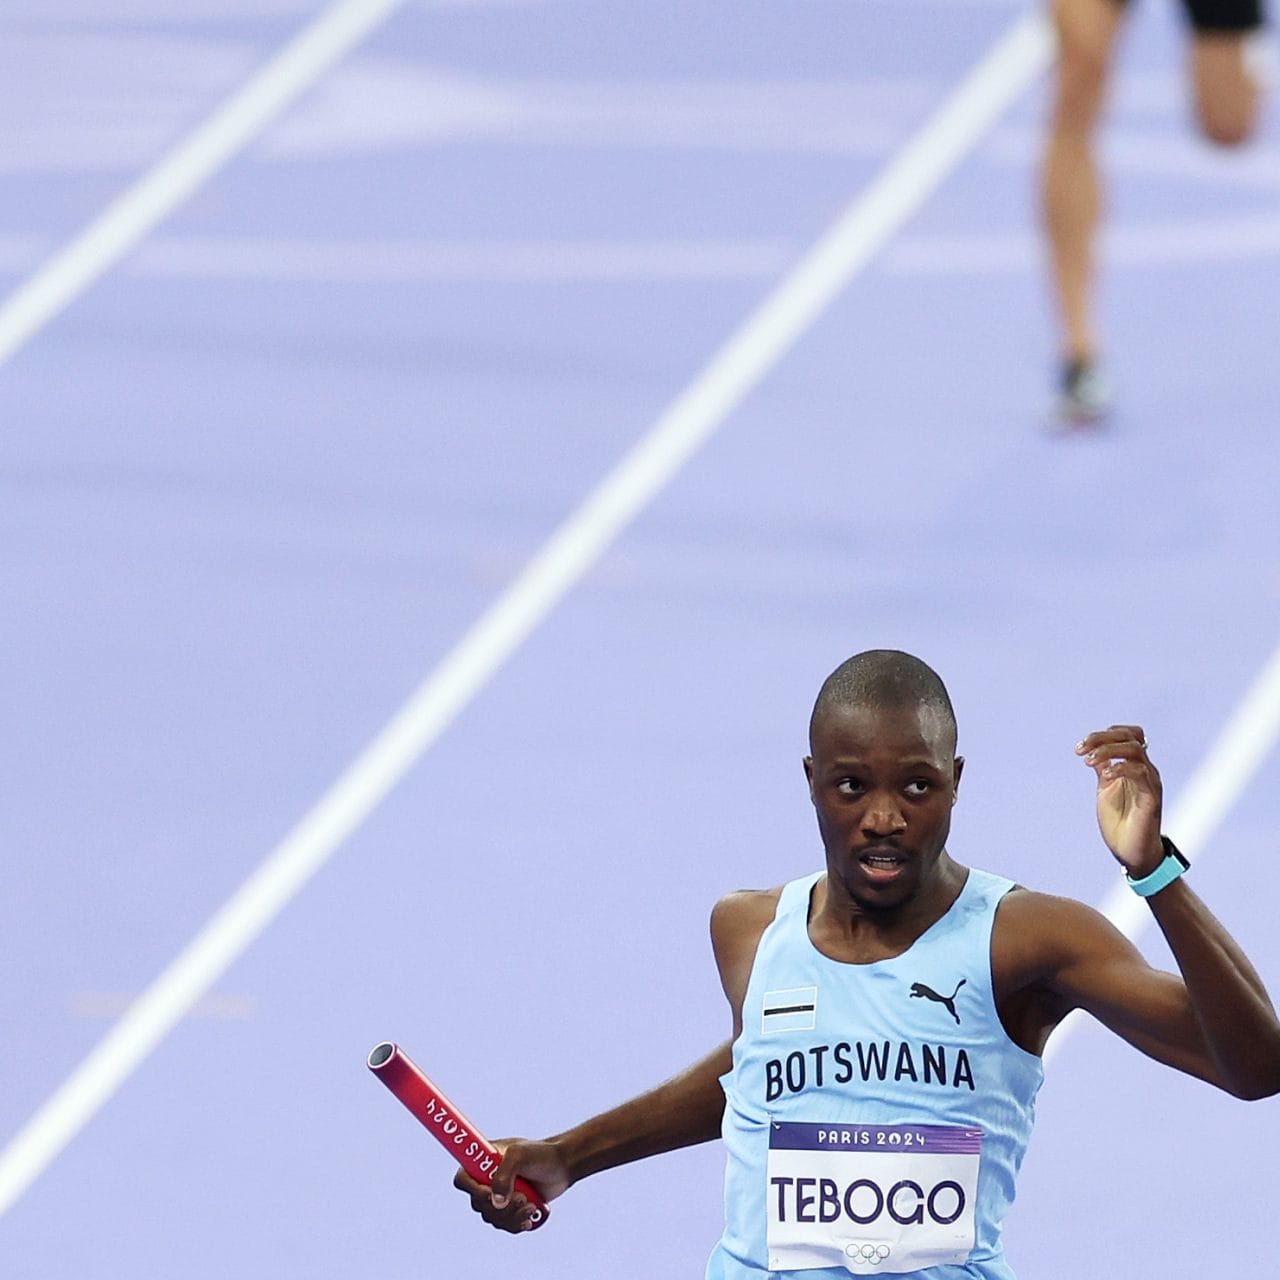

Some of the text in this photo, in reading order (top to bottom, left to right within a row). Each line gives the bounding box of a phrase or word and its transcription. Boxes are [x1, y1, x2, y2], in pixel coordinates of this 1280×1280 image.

[765, 1040, 975, 1102] BOTSWANA
[426, 1098, 468, 1144] 2024
[818, 1130, 925, 1146] PARIS 2024
[771, 1177, 966, 1225] TEBOGO
